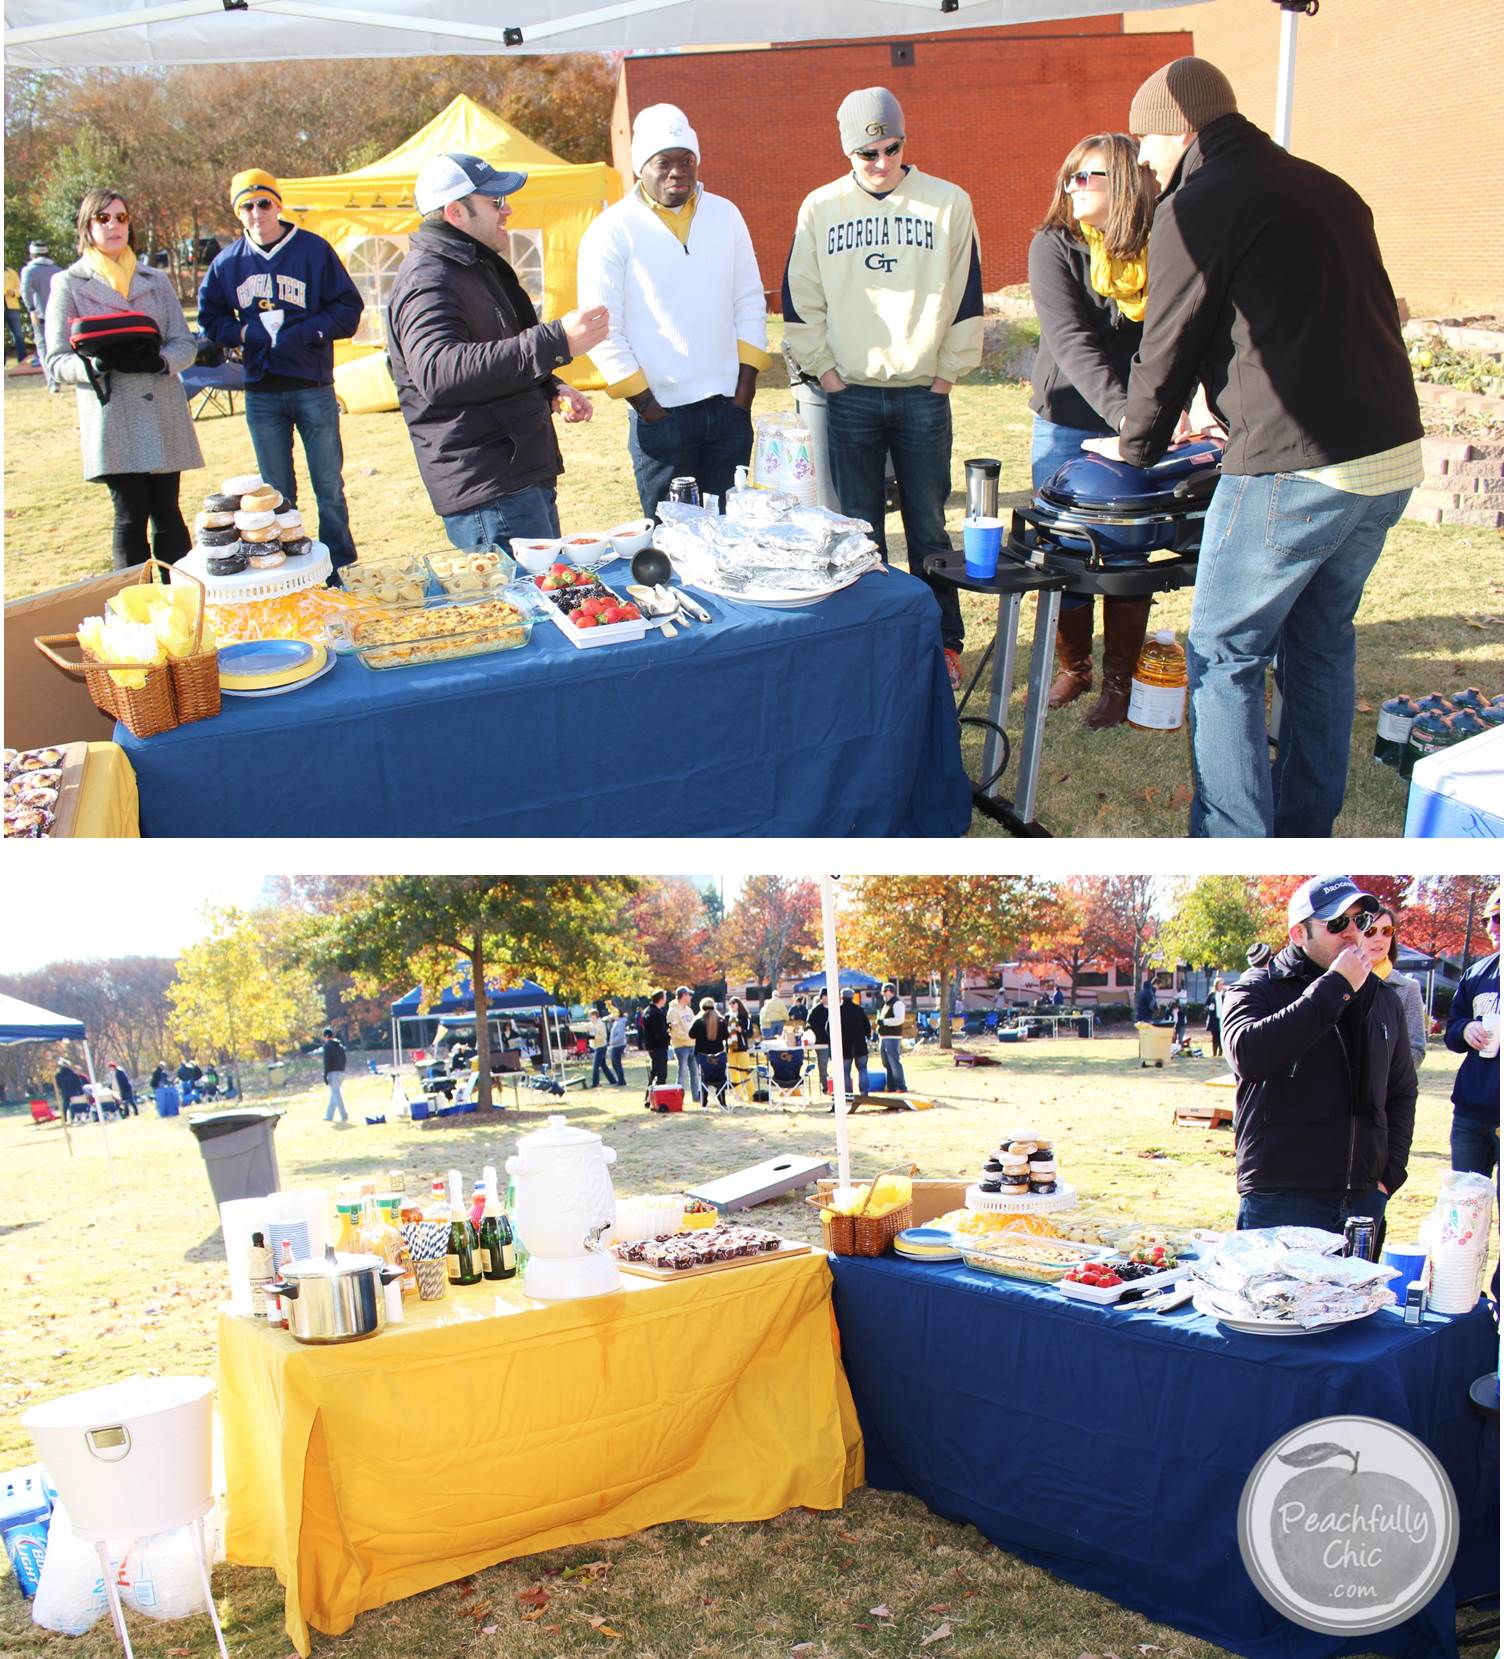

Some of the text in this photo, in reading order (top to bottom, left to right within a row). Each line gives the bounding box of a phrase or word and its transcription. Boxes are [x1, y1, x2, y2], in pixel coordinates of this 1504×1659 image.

[865, 122, 888, 136] GT
[827, 216, 934, 255] GEORGIA TECH
[865, 252, 898, 273] GT
[236, 273, 307, 309] GEGIA TECH
[17, 1544, 40, 1586] LIGHT
[31, 1548, 46, 1570] BU
